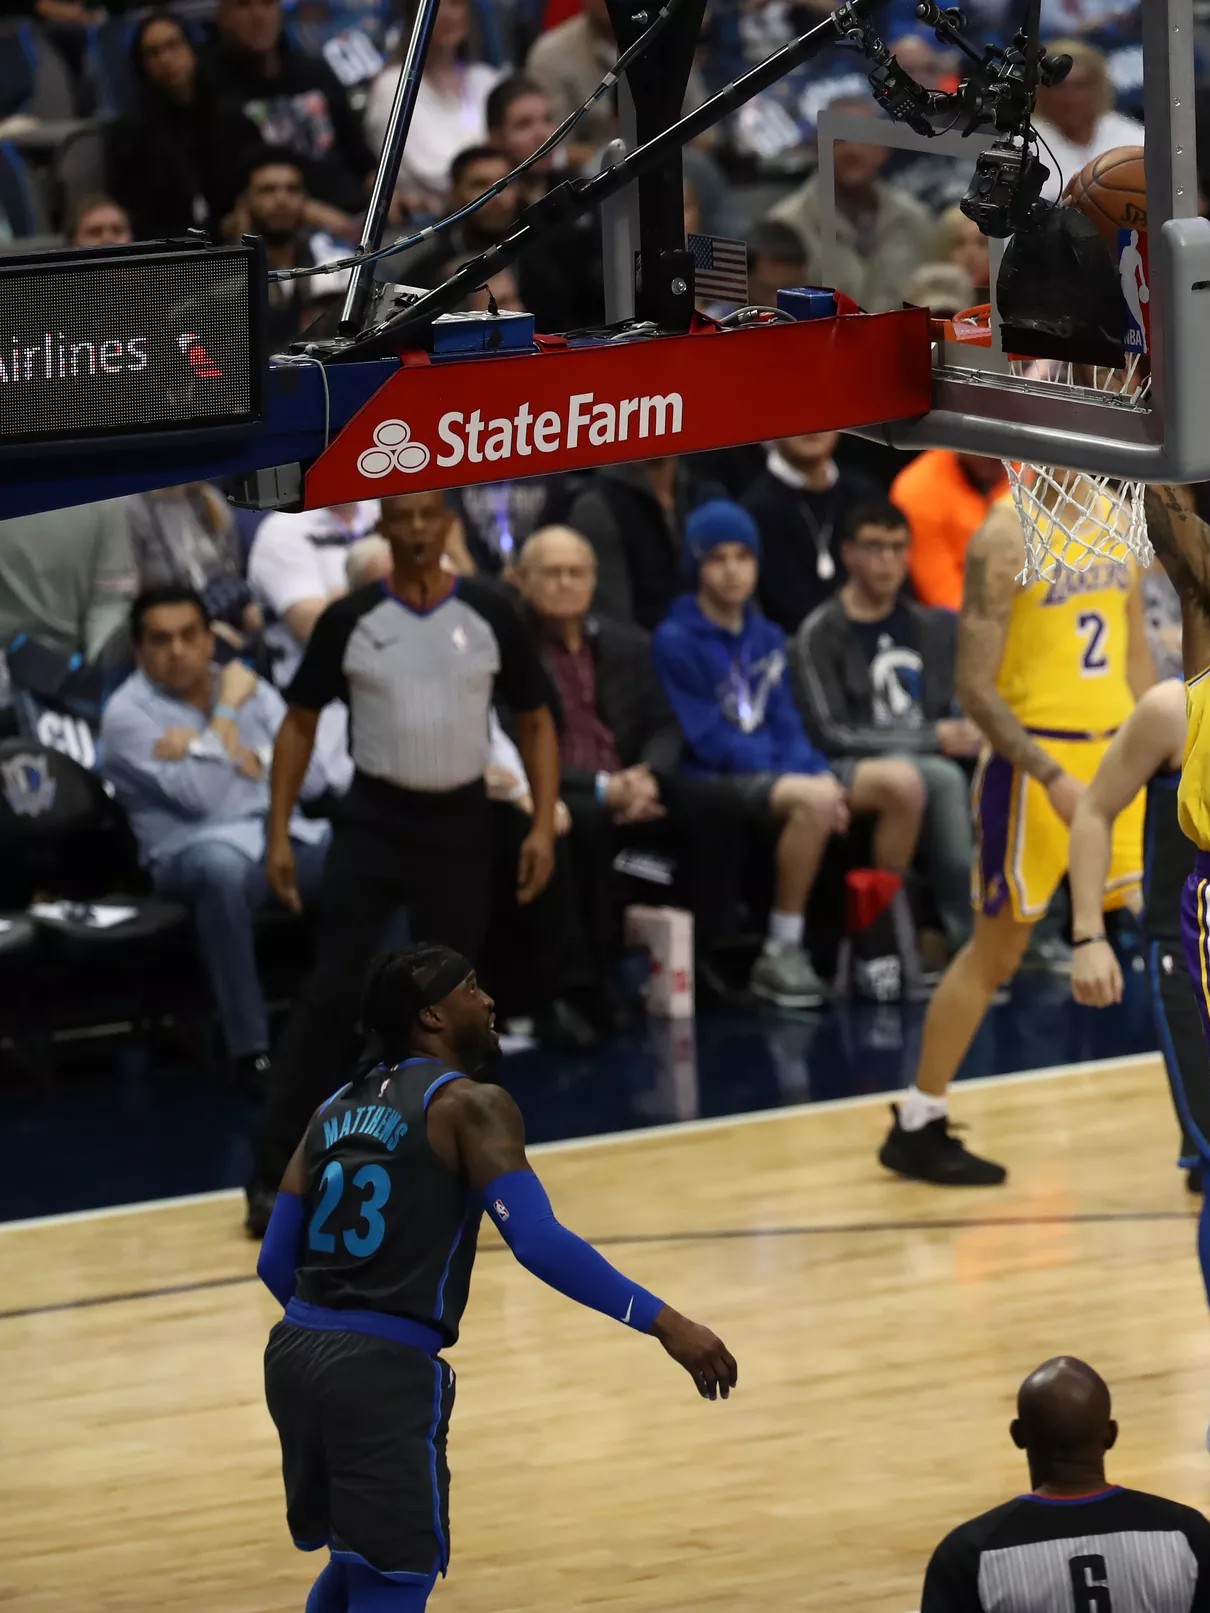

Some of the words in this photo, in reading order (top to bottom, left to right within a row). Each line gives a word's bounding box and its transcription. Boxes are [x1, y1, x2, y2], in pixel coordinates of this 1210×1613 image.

[1077, 611, 1108, 677] 2
[322, 1104, 409, 1152] MATTHEWS
[308, 1160, 392, 1258] 23
[1068, 1553, 1114, 1613] 6
